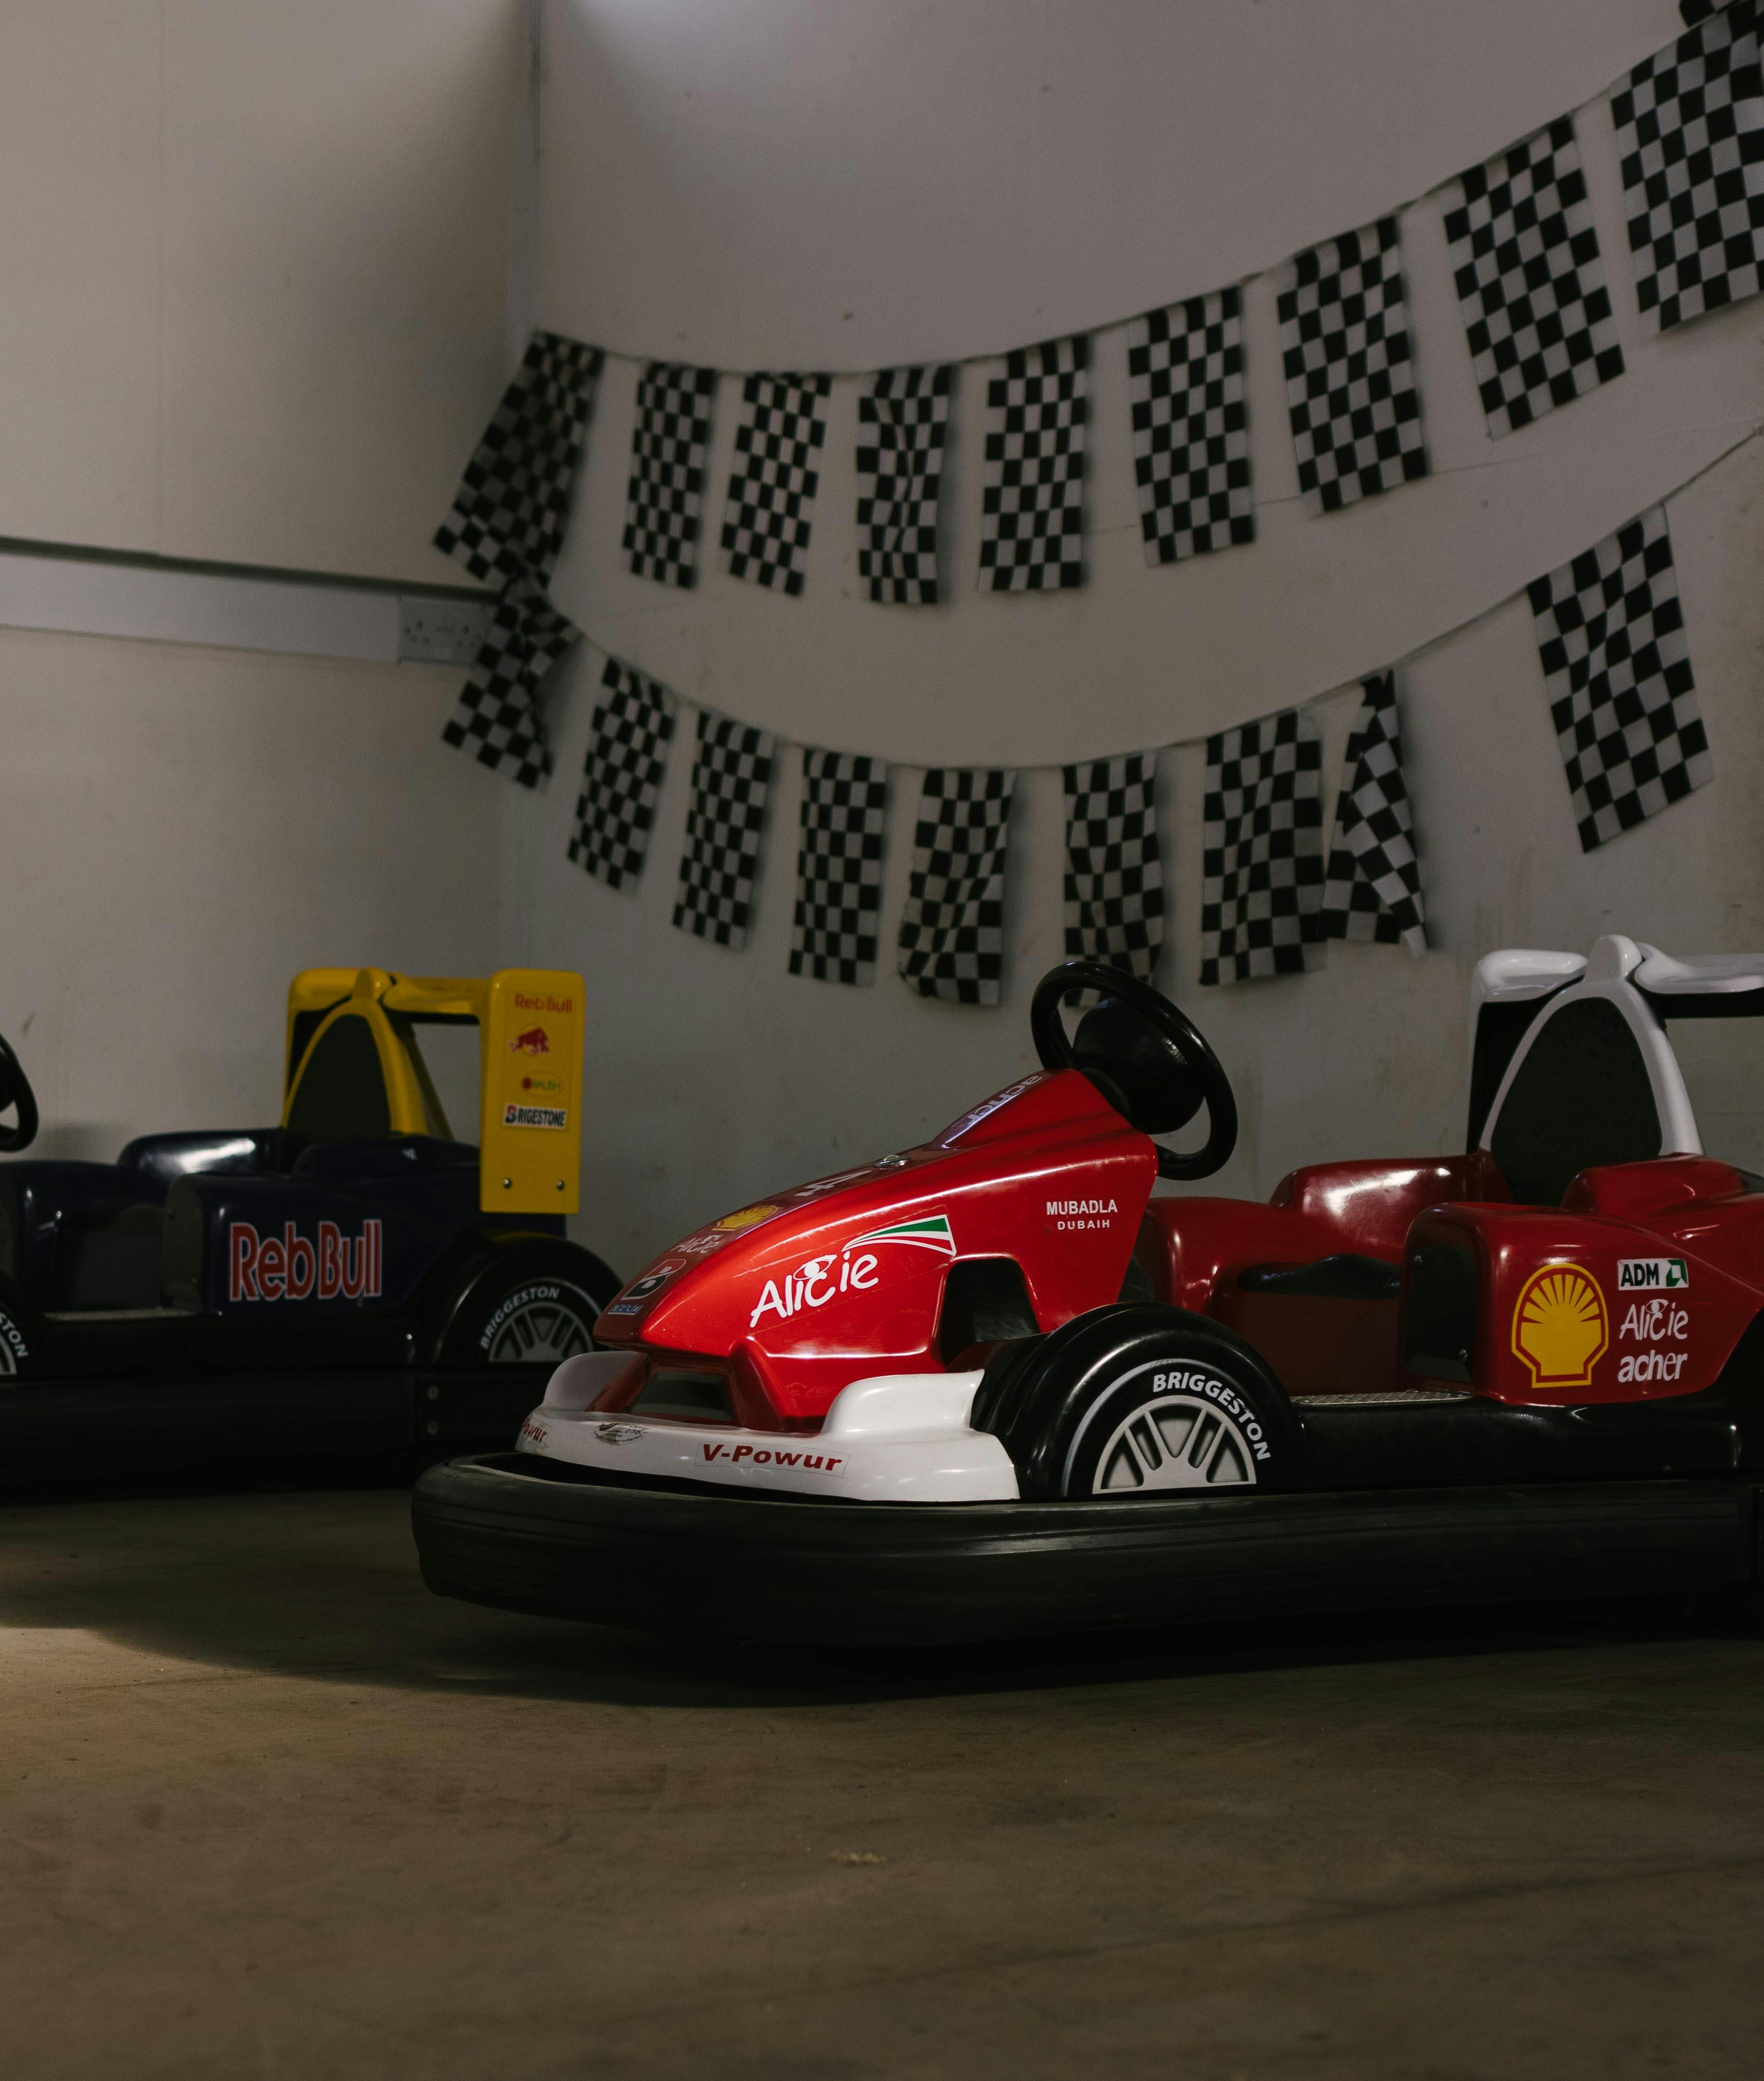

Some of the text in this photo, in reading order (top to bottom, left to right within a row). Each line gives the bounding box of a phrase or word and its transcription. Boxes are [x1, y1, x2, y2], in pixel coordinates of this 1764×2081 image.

[1046, 1199, 1118, 1215] MUBADLA
[1057, 1219, 1110, 1230] DUBAIH
[1620, 1263, 1659, 1287] ADM
[481, 1286, 560, 1350] BRIGGESTON
[1618, 1349, 1689, 1383] acher
[1153, 1371, 1272, 1461] BRIGGESTON
[703, 1443, 842, 1471] V-Powur
